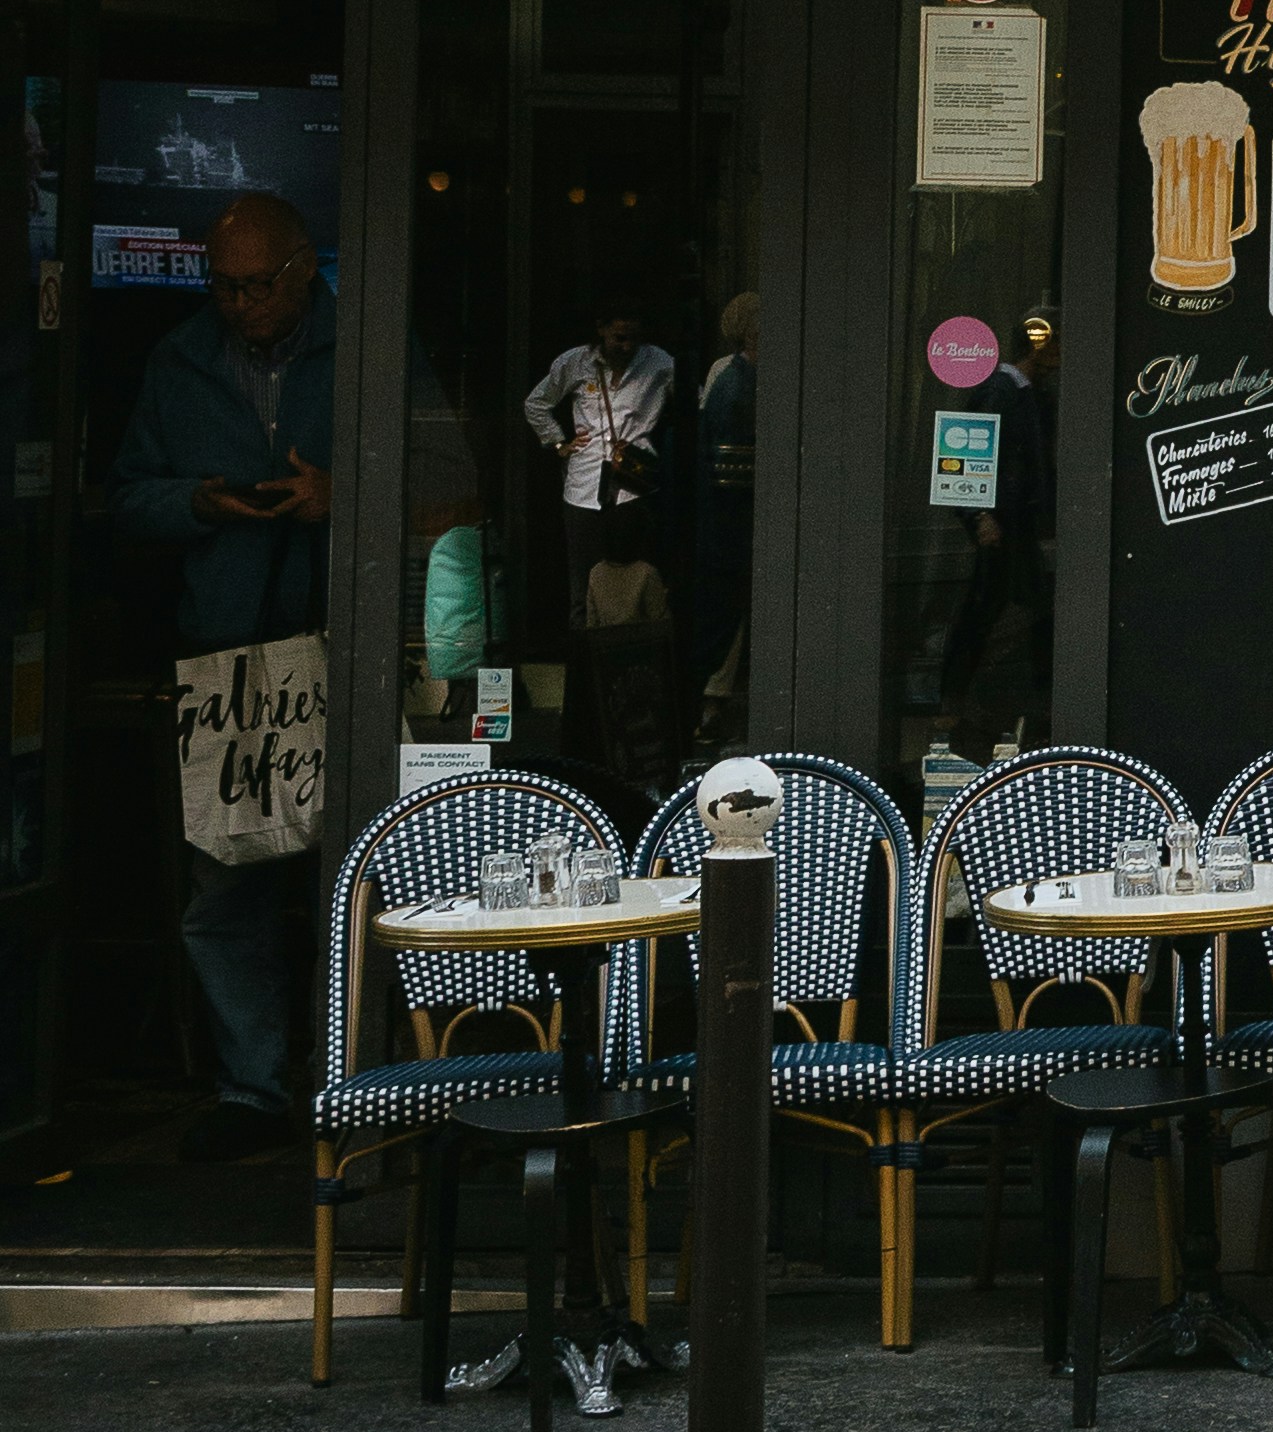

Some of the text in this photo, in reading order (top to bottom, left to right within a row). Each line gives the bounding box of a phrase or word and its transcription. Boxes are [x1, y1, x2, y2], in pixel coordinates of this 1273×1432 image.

[946, 342, 996, 359] Bonbon
[968, 463, 991, 473] VISA
[1161, 456, 1237, 490] Fromages
[1168, 480, 1225, 515] Mixte
[419, 751, 472, 760] PAIEMENT
[437, 760, 485, 768] CONTACT
